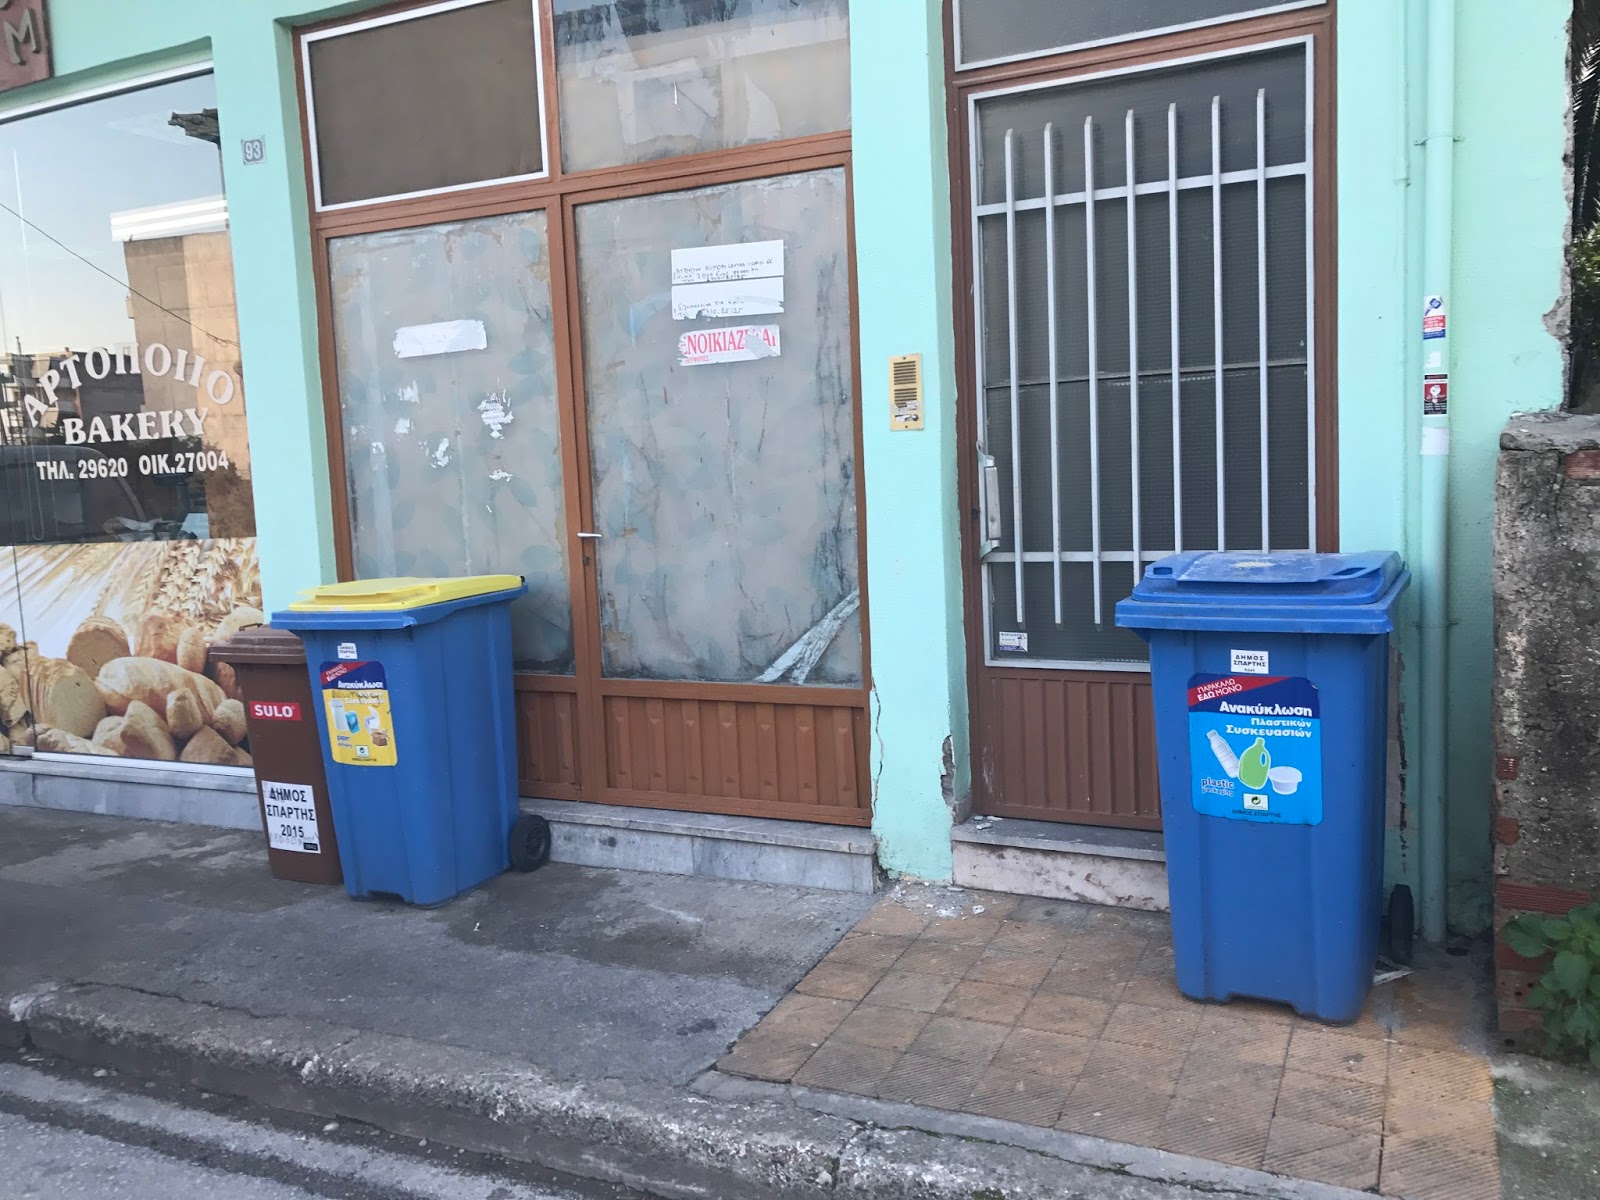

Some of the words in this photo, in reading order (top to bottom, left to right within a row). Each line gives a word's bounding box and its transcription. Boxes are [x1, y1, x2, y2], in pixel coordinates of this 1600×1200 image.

[245, 141, 261, 160] 93
[63, 407, 209, 445] BAKERY
[36, 460, 74, 480] ΤΗΛ.
[78, 457, 128, 479] 29620
[138, 450, 229, 476] ΟΙΚ.27004
[1232, 660, 1267, 668] ΣΠΑΡΤΗΣ
[1197, 678, 1236, 694] ΠΑΡΑΚΑΛΩ
[1197, 691, 1216, 702] ΕΔΩ
[1215, 683, 1243, 697] ΜΟΝΟ
[254, 704, 294, 718] SULO
[1219, 701, 1313, 717] Ανακύκλωση
[1251, 717, 1312, 728] Πλαστικών
[1226, 724, 1312, 738] Συσκευασιών
[1201, 777, 1234, 789] plastic
[269, 787, 307, 803] ΔΗΜΟΣ
[1201, 787, 1234, 797] packaging
[266, 804, 316, 821] ΣΠΑΡΤΗΣ
[280, 824, 305, 838] 2015
